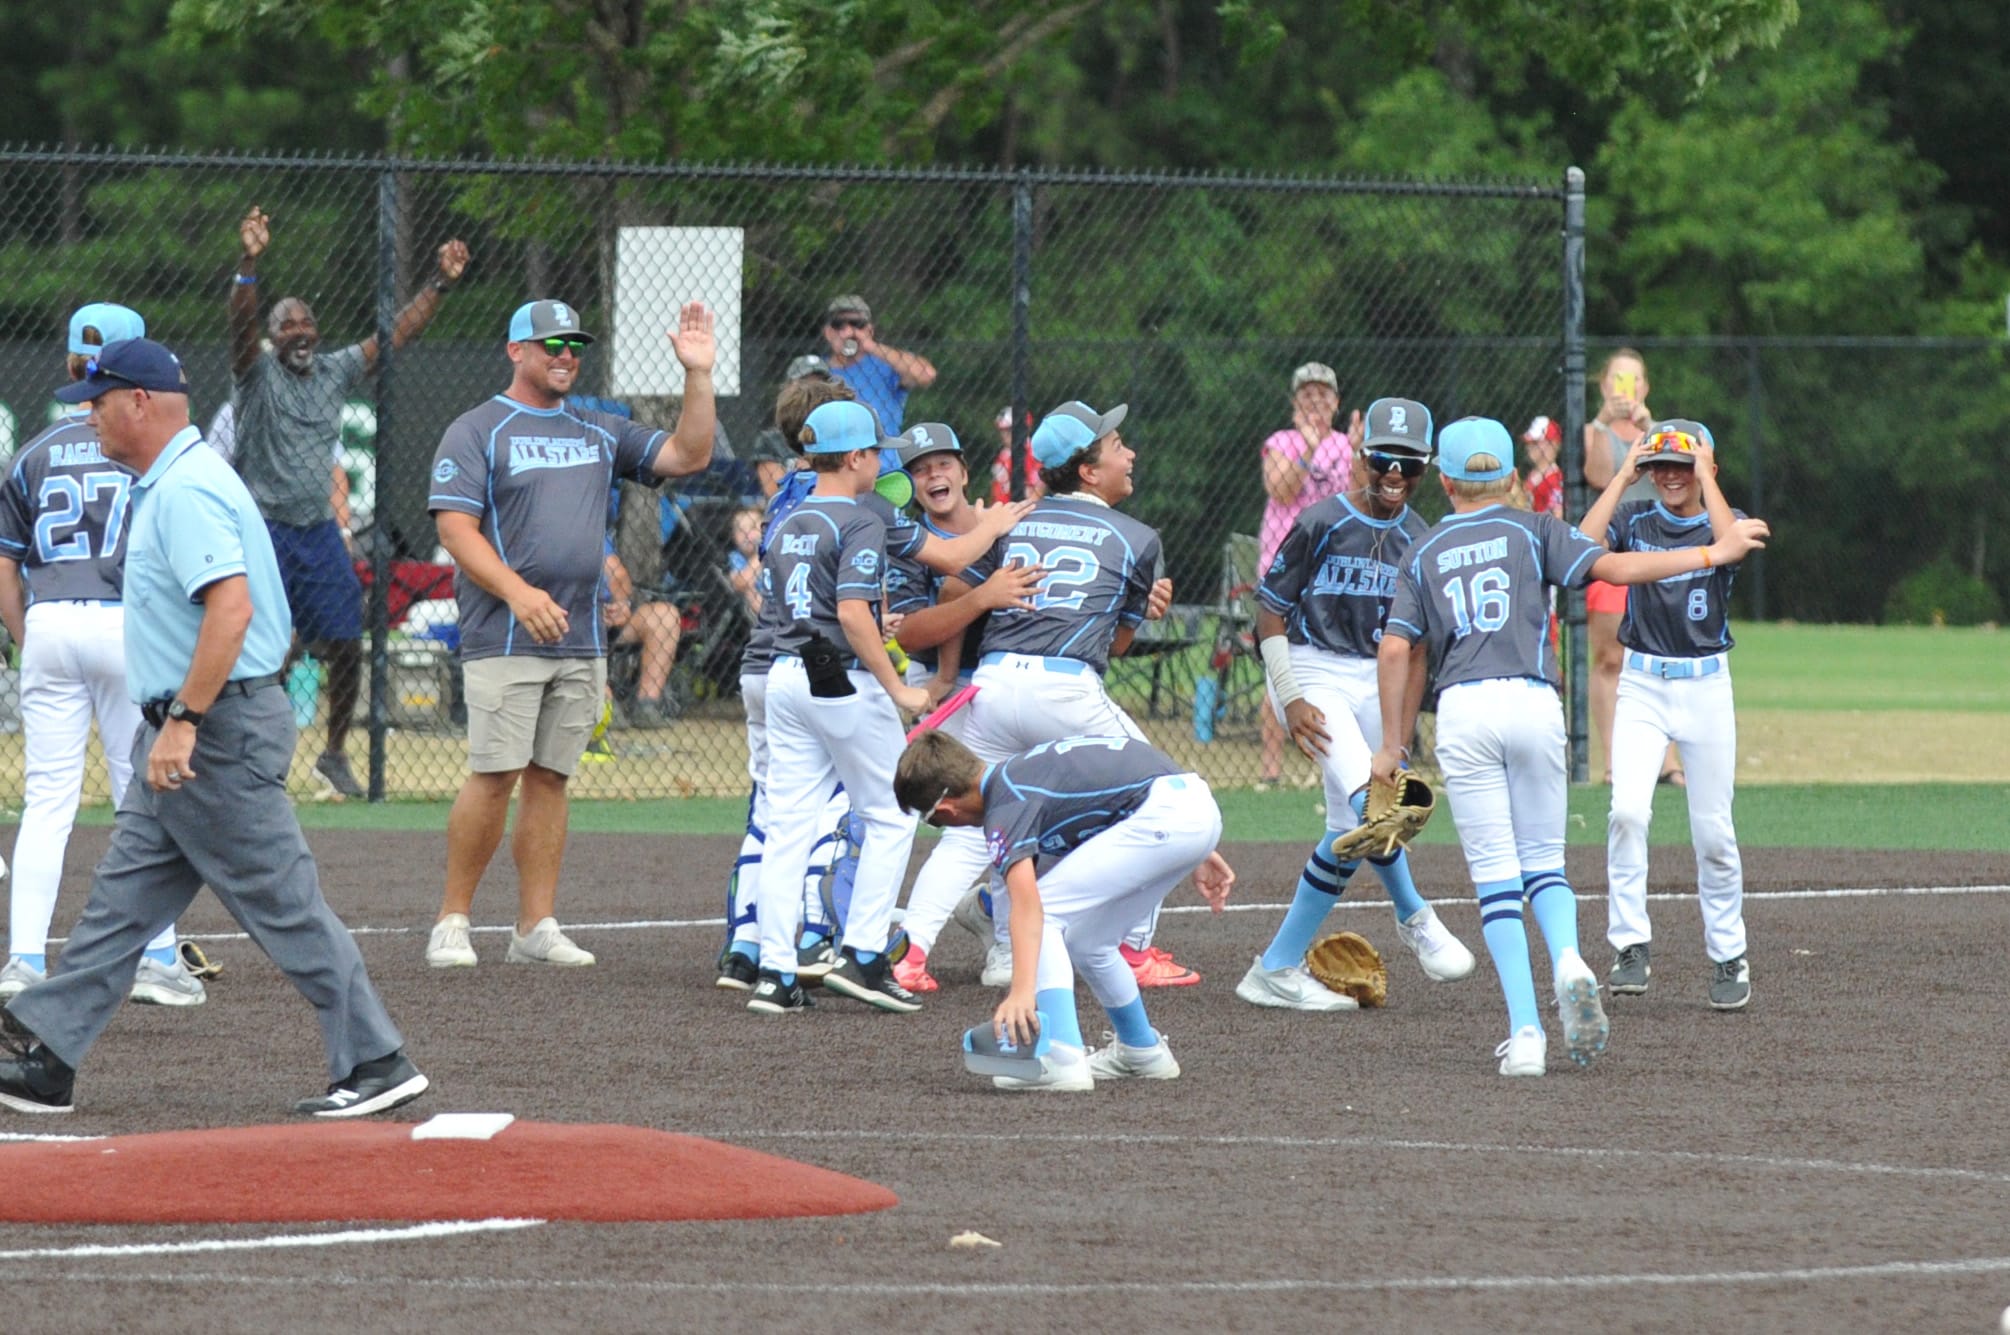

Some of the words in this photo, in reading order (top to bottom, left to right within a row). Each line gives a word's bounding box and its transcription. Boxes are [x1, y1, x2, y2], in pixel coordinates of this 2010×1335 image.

[49, 441, 109, 467] RAGA
[34, 471, 132, 562] 27
[1009, 521, 1113, 546] NTGOMERY
[1437, 536, 1508, 575] SUTTON
[785, 562, 813, 620] 4
[1443, 566, 1510, 641] 16
[1687, 588, 1708, 621] 8
